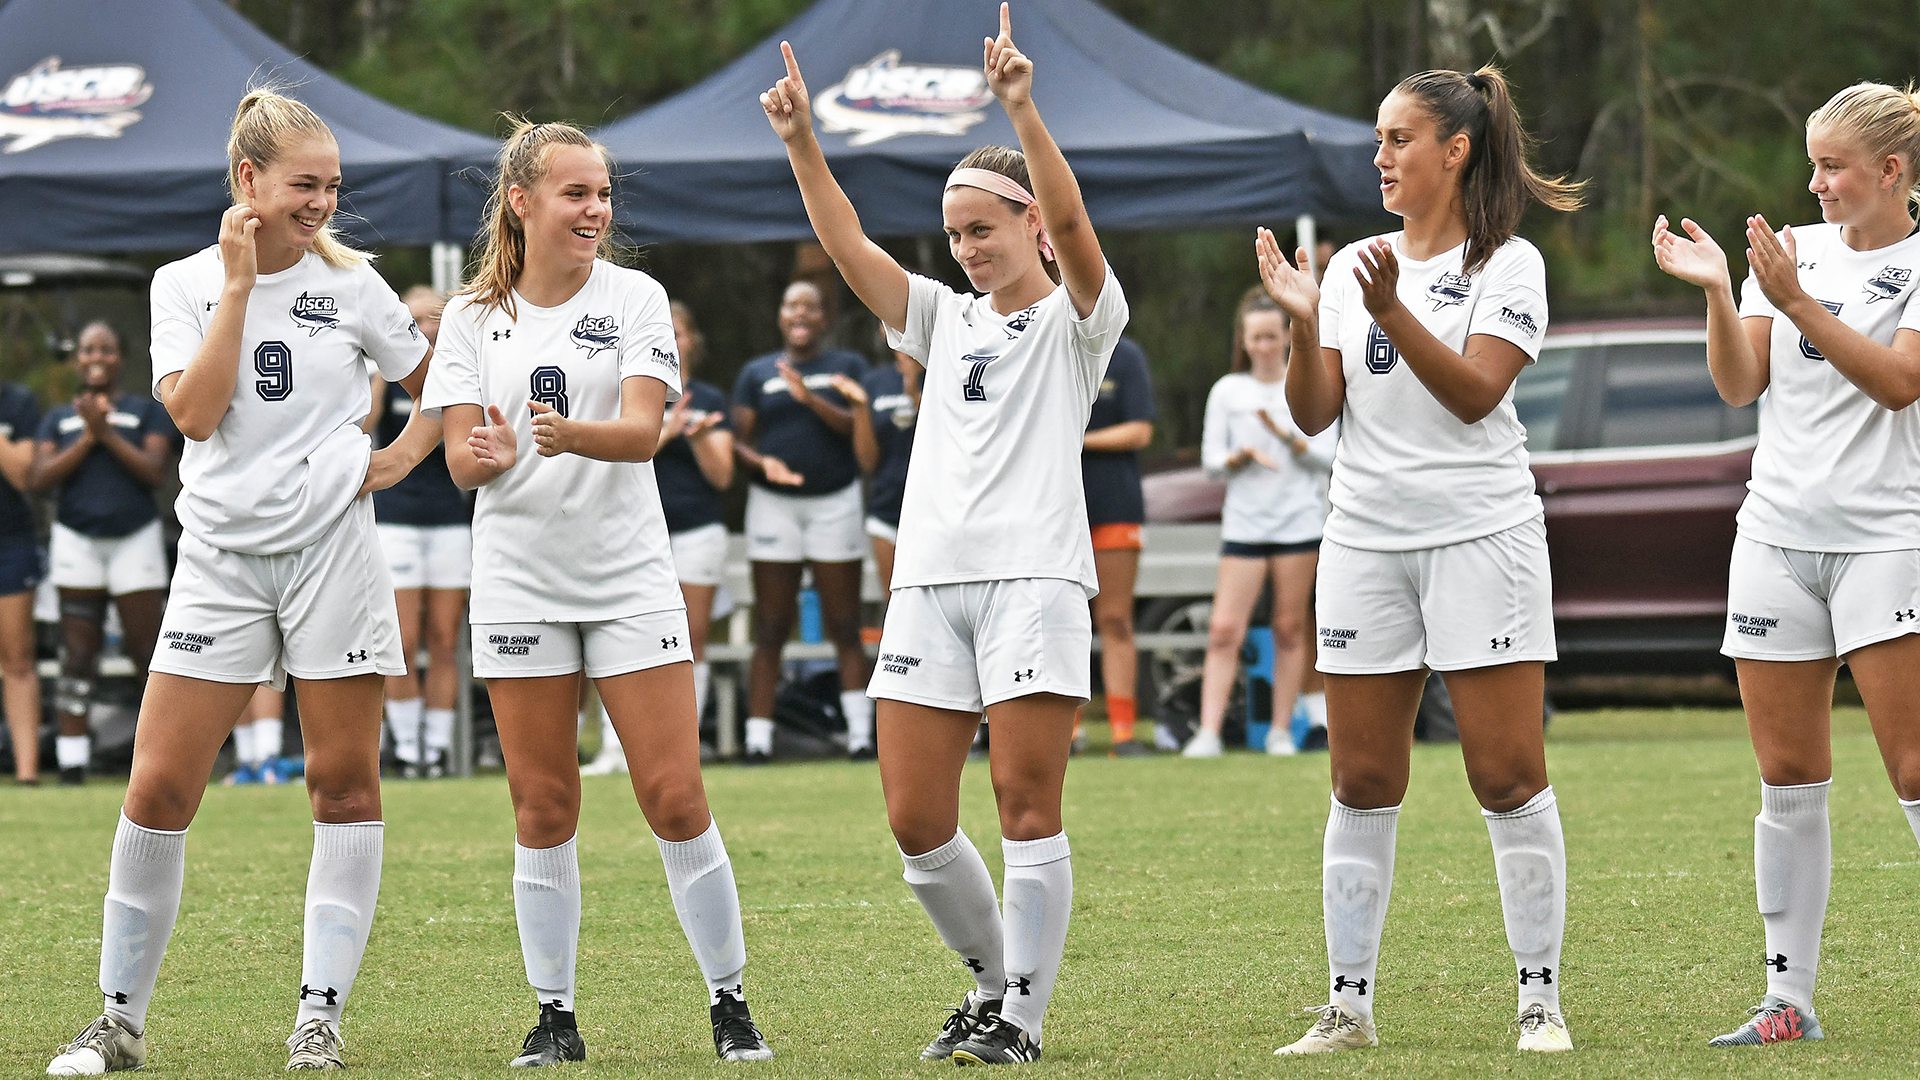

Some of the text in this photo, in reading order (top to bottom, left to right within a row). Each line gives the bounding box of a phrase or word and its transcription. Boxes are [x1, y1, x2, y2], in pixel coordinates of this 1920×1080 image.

[295, 297, 334, 312] USCB
[576, 316, 614, 333] USCB
[1502, 307, 1538, 333] The Sun
[651, 347, 669, 361] The
[254, 341, 293, 401] 9
[961, 354, 1000, 402] 7
[530, 366, 569, 420] 8
[1731, 613, 1779, 628] SAND SHARK
[1331, 629, 1358, 640] SHARK
[1738, 625, 1767, 637] SOCCER
[163, 631, 216, 646] SAND SHARK
[489, 634, 541, 646] SAND SHARK
[1323, 638, 1347, 650] SOCCER
[169, 641, 202, 654] SOCCER
[497, 645, 530, 656] SOCCER
[894, 655, 922, 667] SHARK
